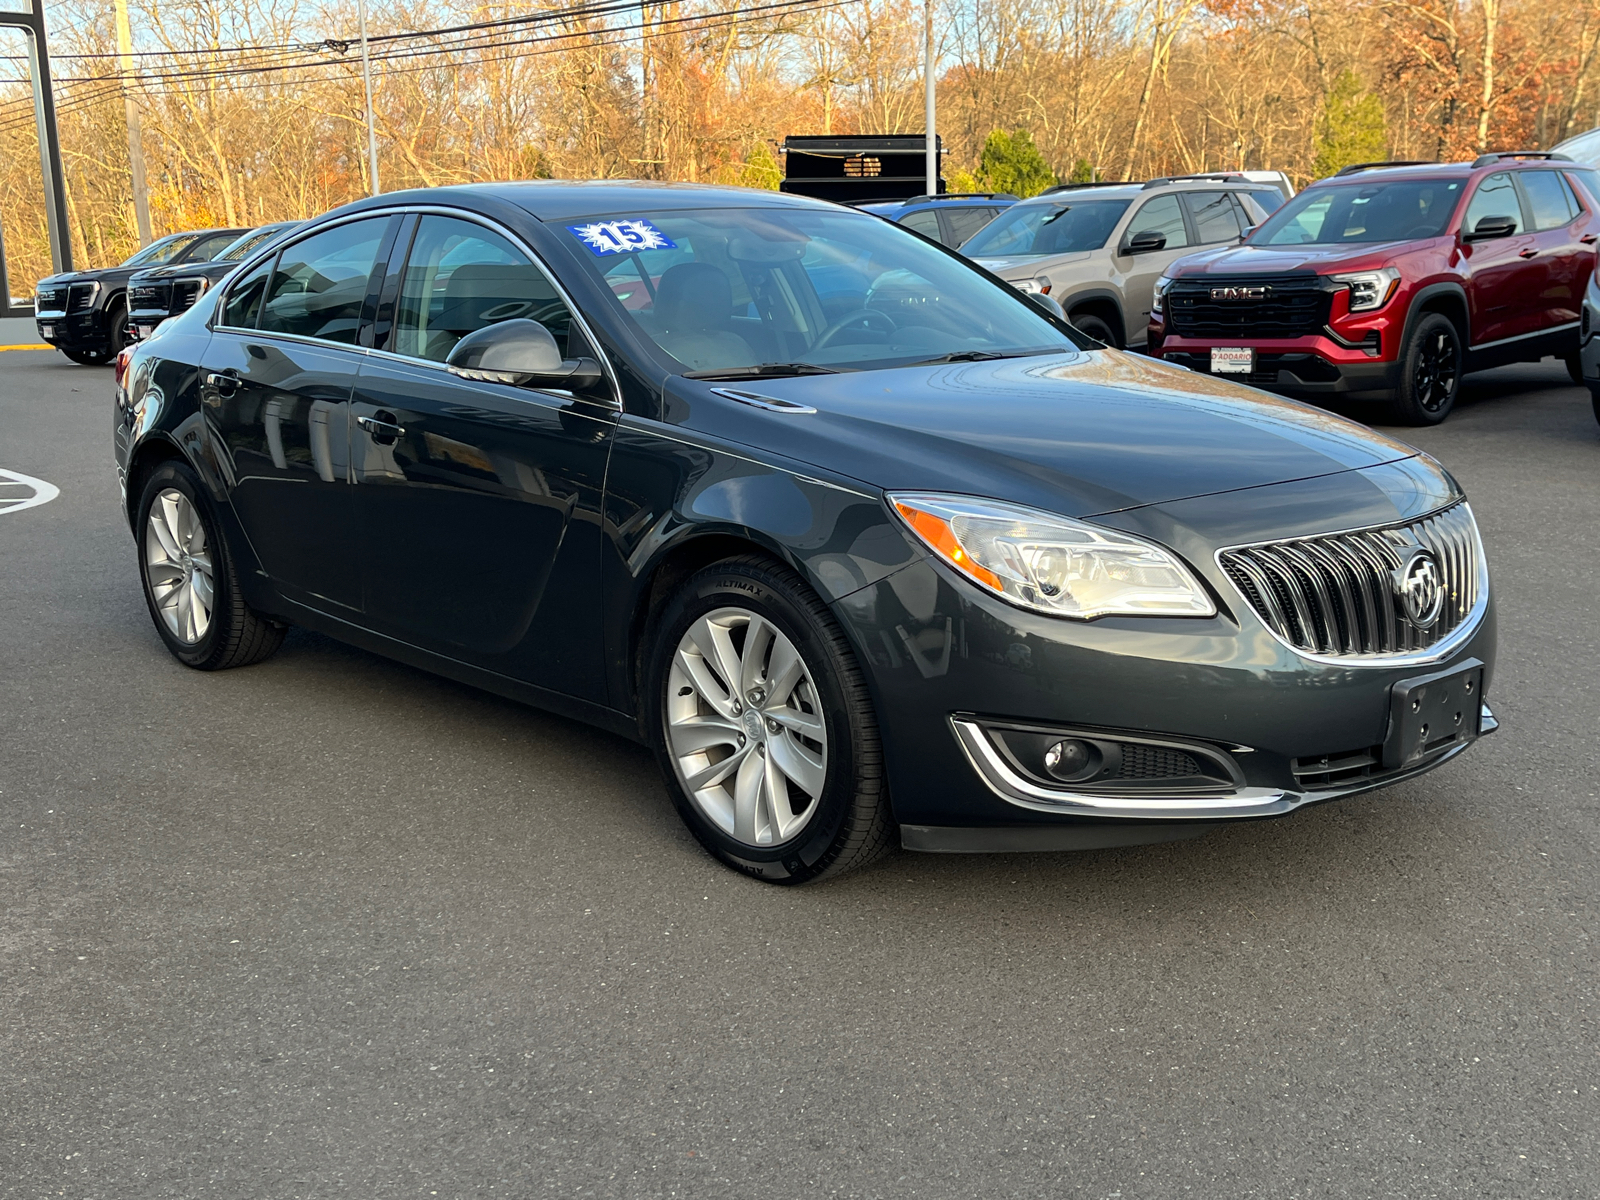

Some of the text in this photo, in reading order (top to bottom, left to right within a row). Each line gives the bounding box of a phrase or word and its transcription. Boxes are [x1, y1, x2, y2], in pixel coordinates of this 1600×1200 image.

[599, 225, 644, 246] 15
[135, 287, 156, 295] GMC
[1211, 287, 1265, 300] GMC
[715, 580, 763, 596] ALTIMAX
